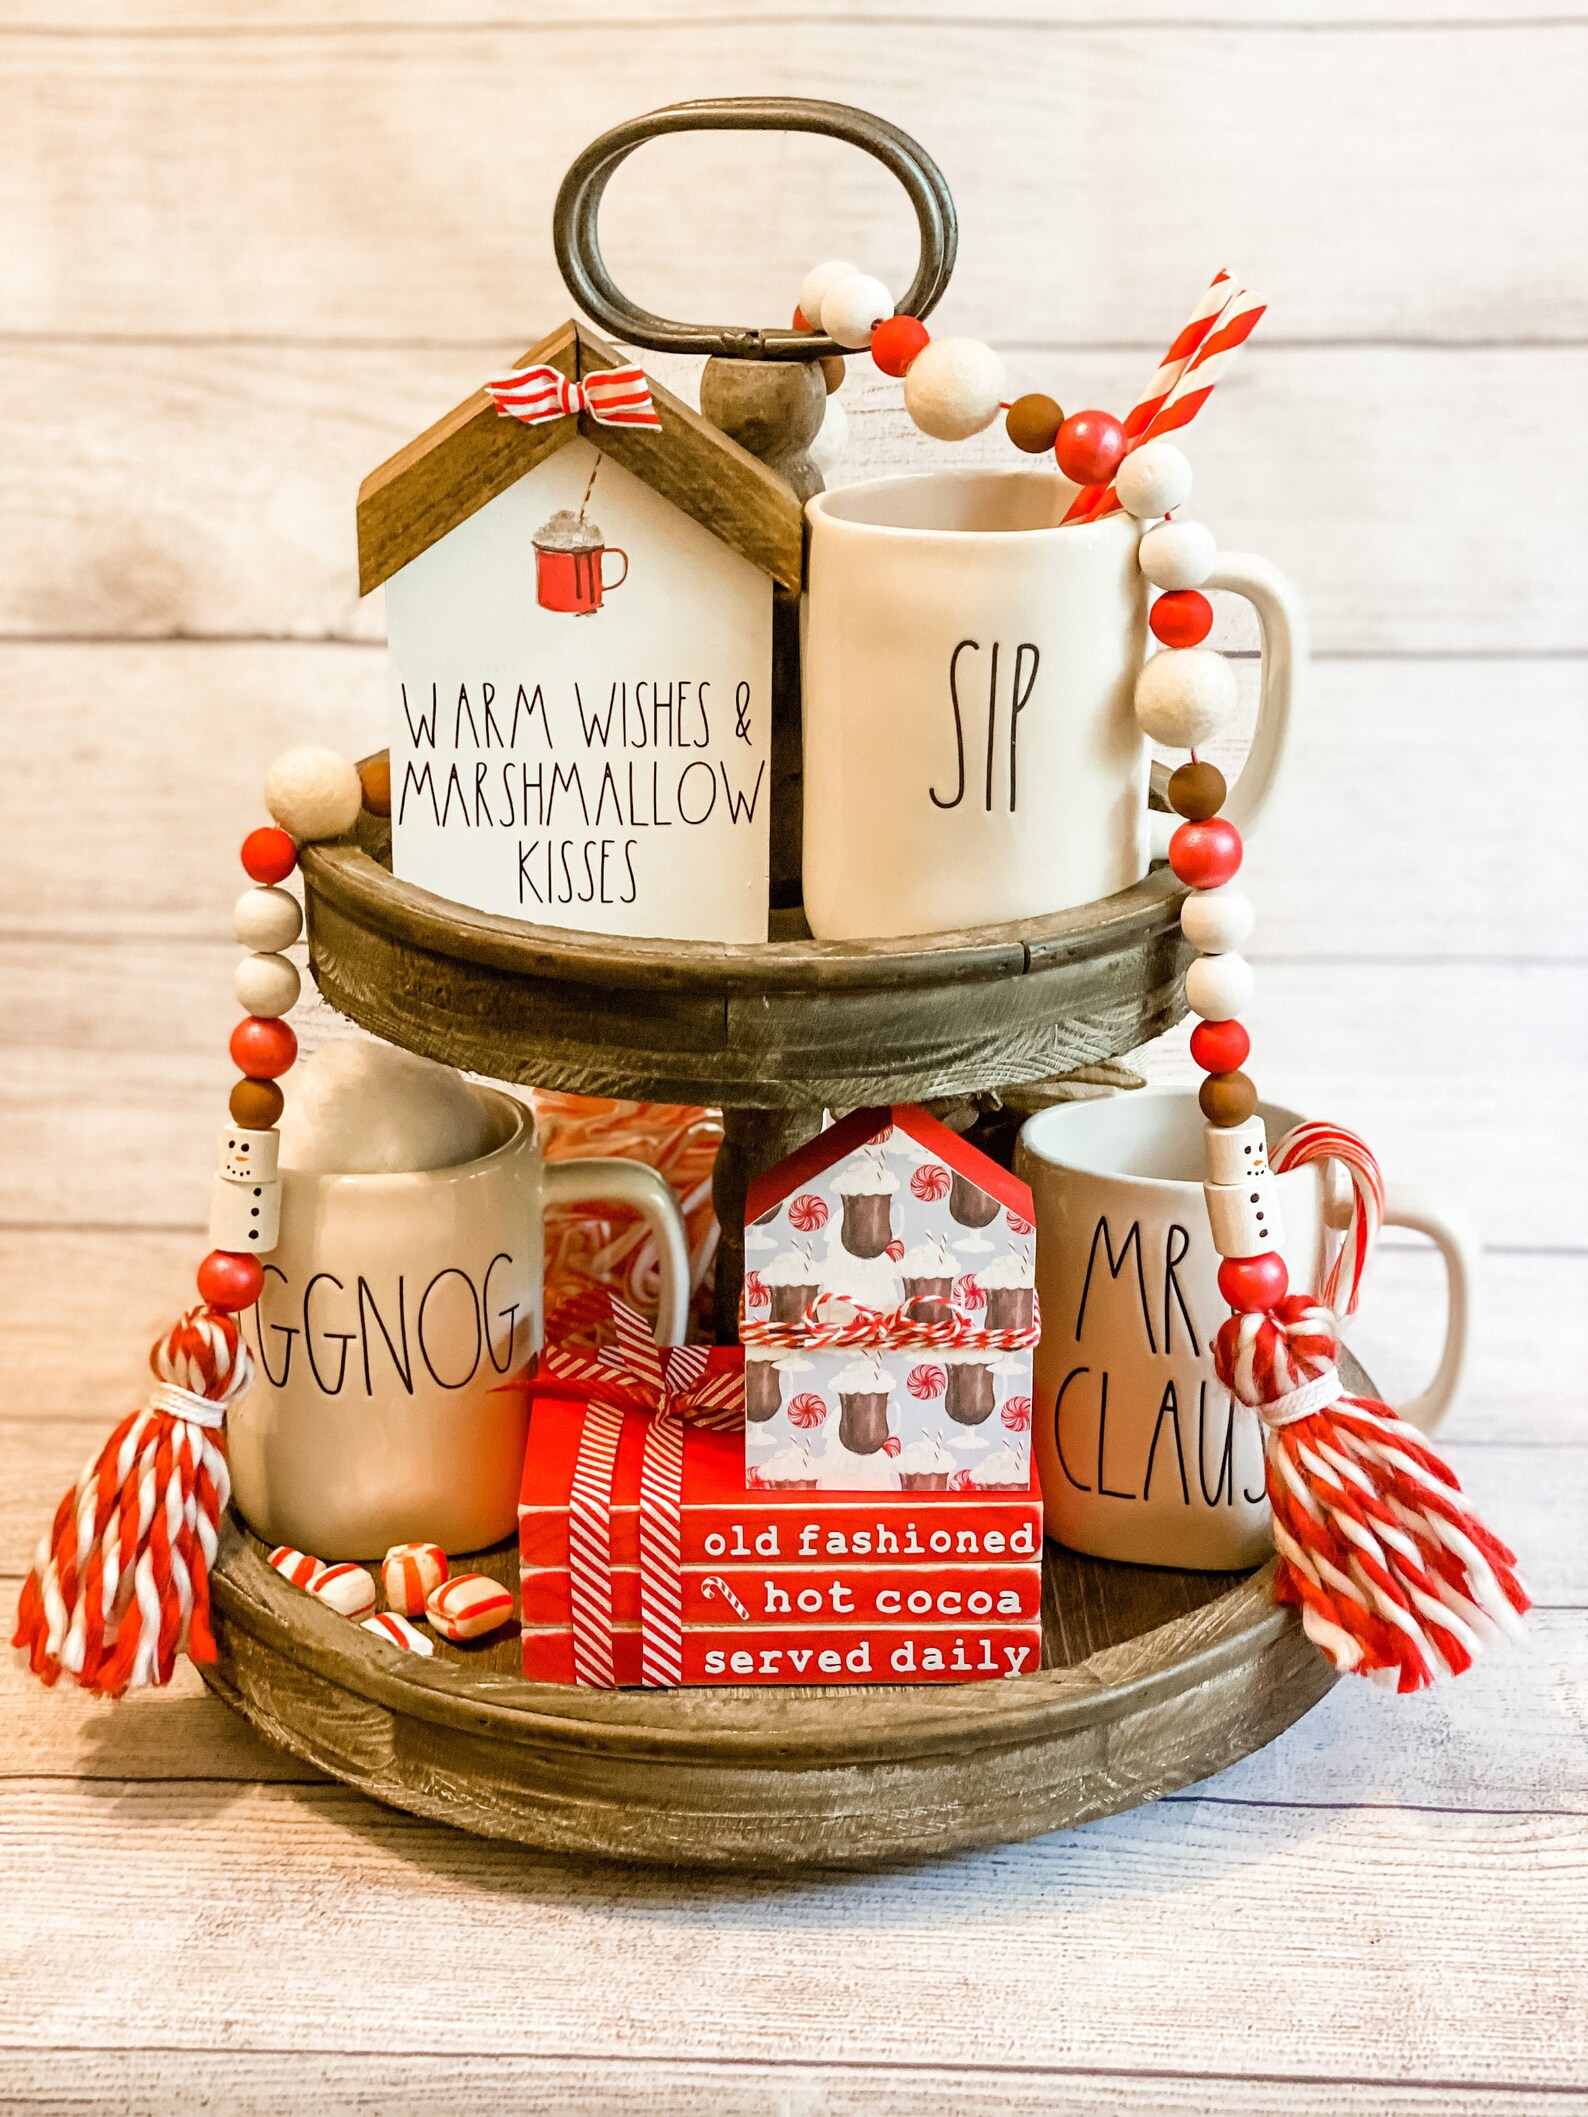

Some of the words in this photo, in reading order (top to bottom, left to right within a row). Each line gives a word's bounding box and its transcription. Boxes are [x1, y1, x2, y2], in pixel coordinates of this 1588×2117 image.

[401, 682, 553, 749] WARM
[574, 681, 711, 749] WISHES
[734, 681, 753, 747] &
[928, 639, 1040, 812] SIP
[398, 759, 766, 827] MARSHMALLOW
[518, 839, 639, 904] KISSES
[1075, 1215, 1237, 1357] MR
[236, 1252, 520, 1397] GGNOG
[704, 1524, 781, 1557] old
[798, 1522, 1036, 1556] fashioned
[763, 1580, 855, 1613] hot
[875, 1588, 1022, 1614] cocoa
[704, 1641, 872, 1674] served
[890, 1638, 1031, 1678] daily
